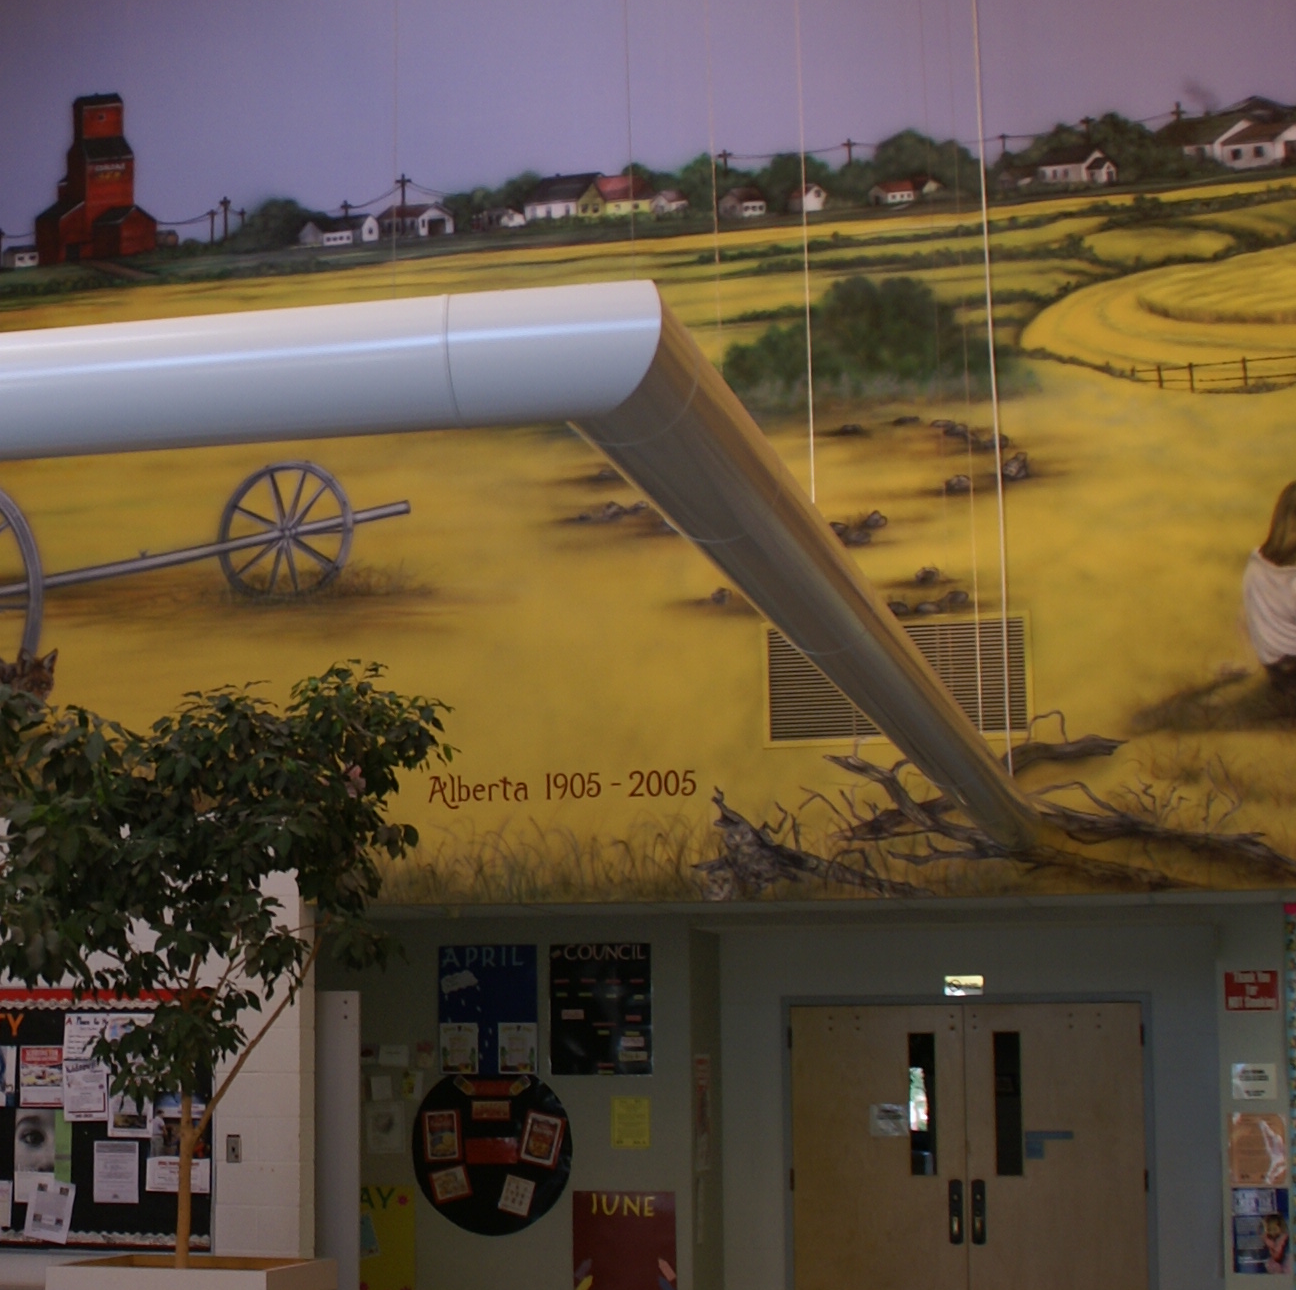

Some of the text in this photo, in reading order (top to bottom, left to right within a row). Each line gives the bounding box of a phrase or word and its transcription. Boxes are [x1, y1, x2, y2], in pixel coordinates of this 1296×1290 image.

[428, 773, 527, 809] Alberta
[544, 772, 600, 799] 1905
[627, 770, 694, 797] 2005
[442, 945, 524, 968] APRIL
[564, 944, 647, 961] COUNCIL
[360, 1188, 395, 1210] AY
